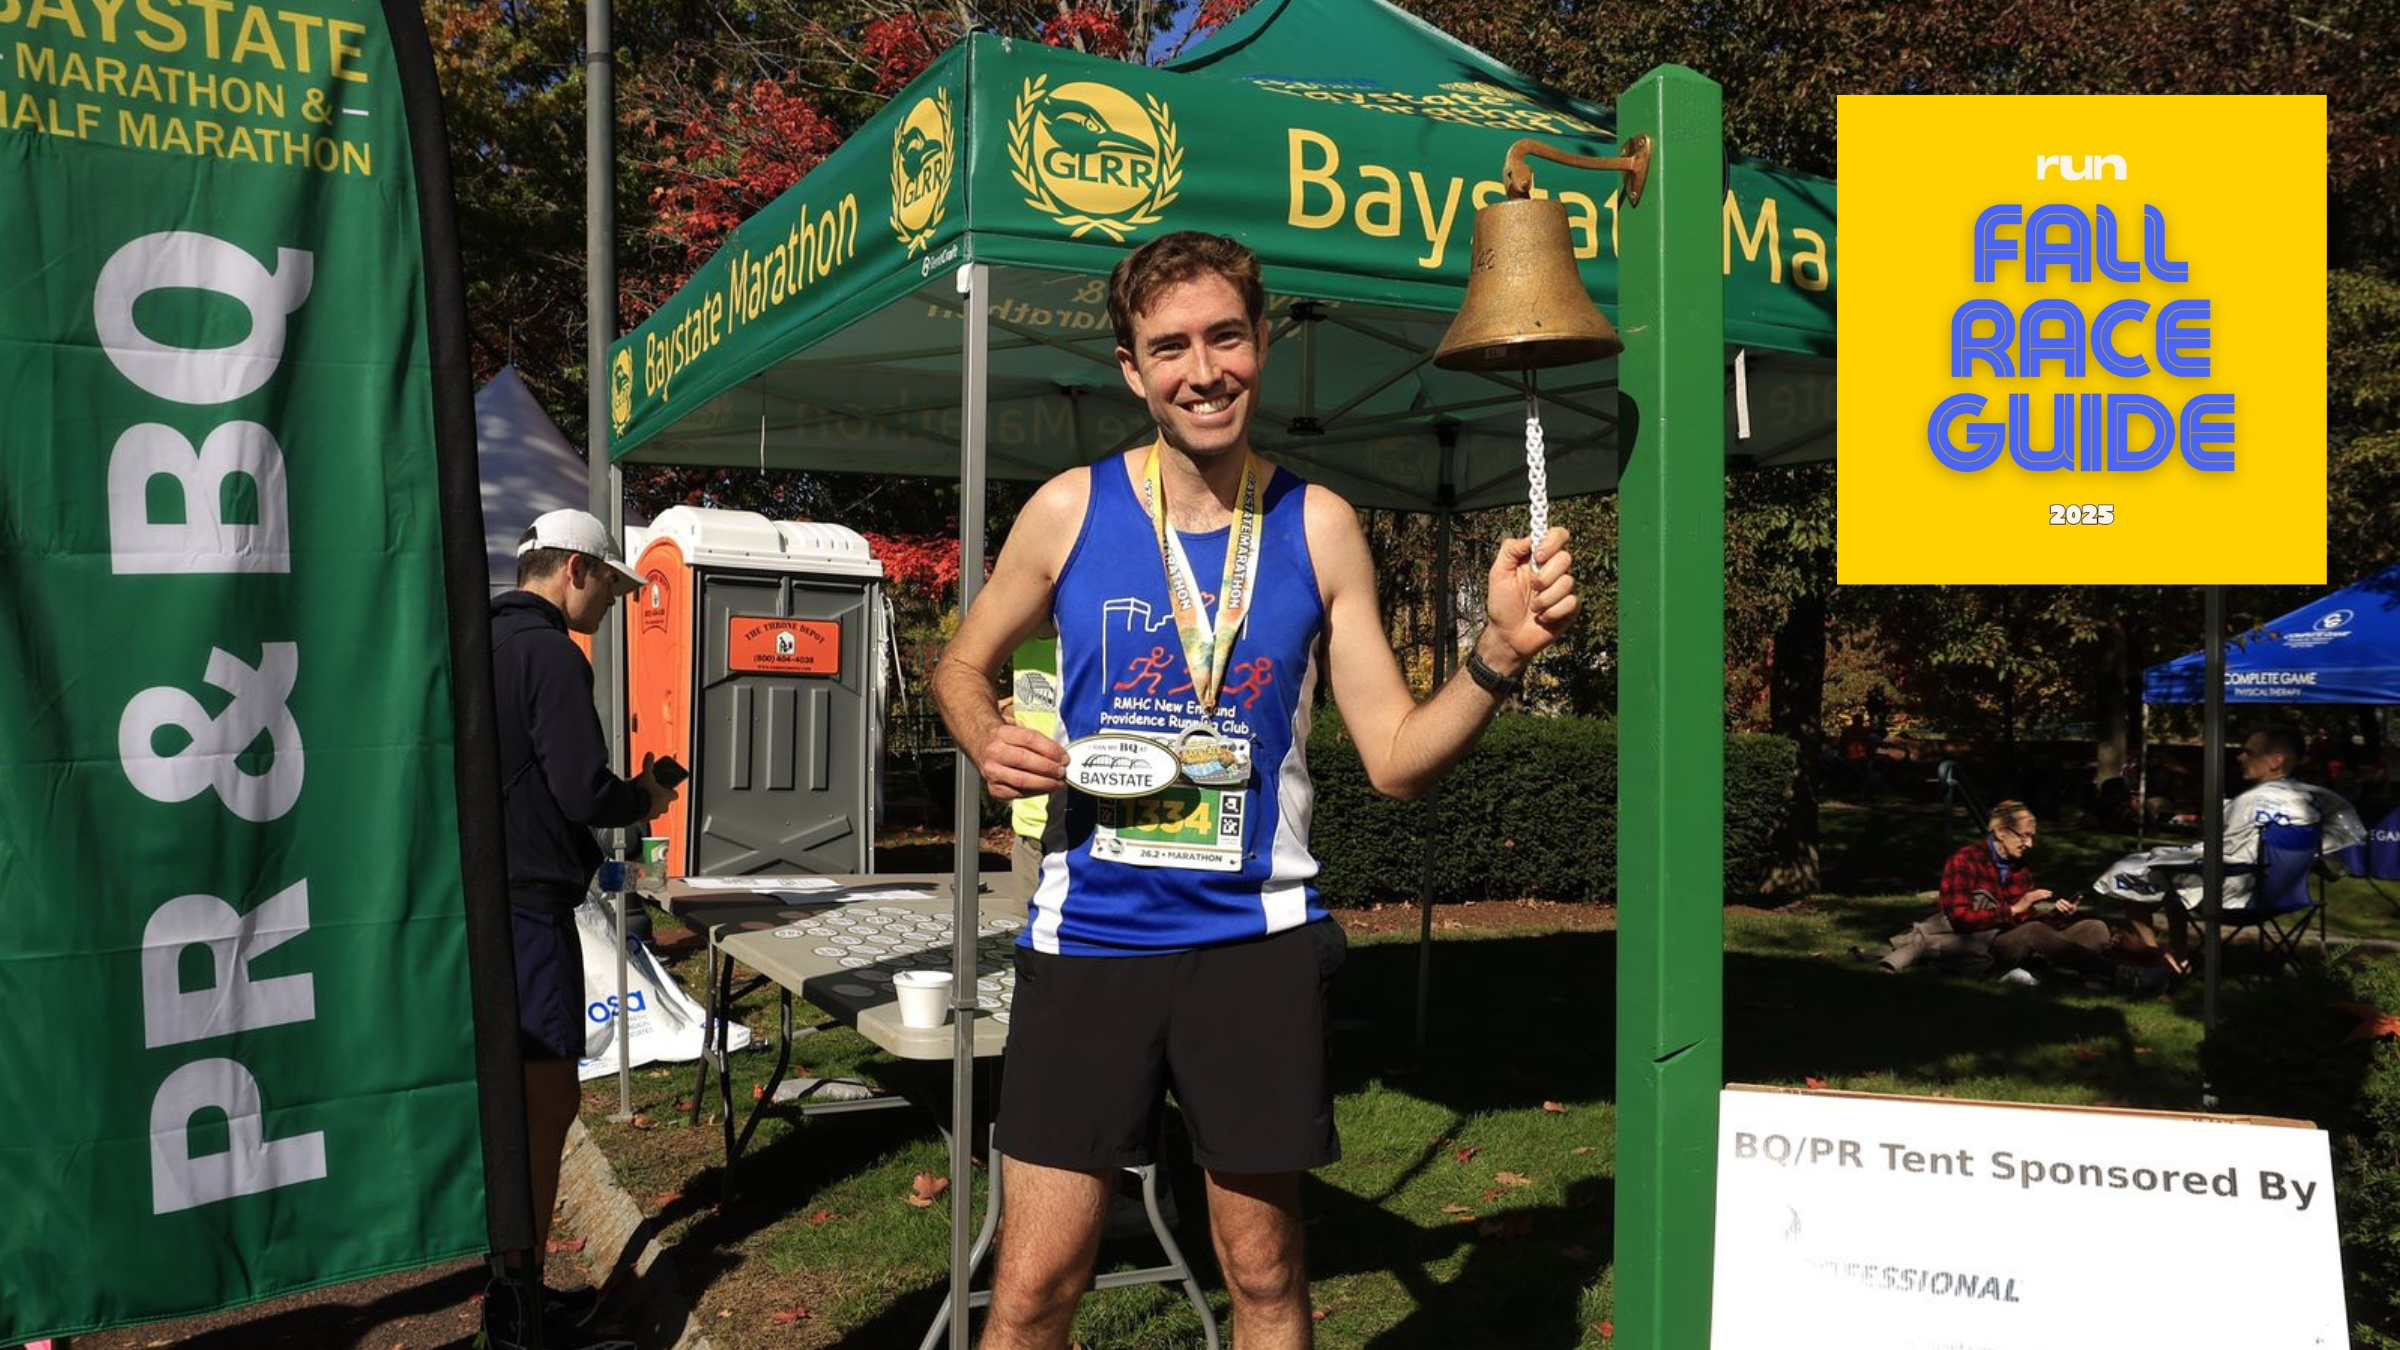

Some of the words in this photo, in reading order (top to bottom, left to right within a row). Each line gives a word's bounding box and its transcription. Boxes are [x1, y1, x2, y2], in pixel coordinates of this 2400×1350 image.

[0, 0, 369, 83] AYSTATE
[14, 42, 286, 118] MARATHON
[301, 87, 333, 126] &
[118, 109, 371, 176] MARATHON
[1042, 145, 1156, 190] GLRR
[902, 157, 944, 208] GLRR
[1287, 128, 1618, 269] Bayat
[1723, 191, 1838, 291] Ma
[644, 290, 723, 402] Baystate
[728, 192, 858, 335] Marathon
[93, 230, 314, 575] BQ
[1164, 543, 1192, 611] RATHON
[1228, 535, 1252, 609] MARATHON
[745, 626, 762, 641] THE
[763, 621, 799, 632] THRONE
[799, 624, 825, 644] DEPOT
[1113, 697, 1152, 711] RMHC
[1154, 701, 1184, 714] New
[1186, 701, 1237, 718] Enand
[2280, 672, 2318, 685] GAME
[117, 641, 305, 823] &
[1100, 712, 1166, 727] Providence
[1221, 720, 1250, 735] Club
[1119, 742, 1138, 754] BQ
[1080, 771, 1153, 788] BAYSTATE
[1122, 800, 1213, 836] 1334
[1140, 849, 1160, 859] 26.2
[1167, 851, 1223, 863] MARATHON
[141, 877, 328, 1216] PR
[1734, 1131, 1864, 1168] BQ/PR
[1879, 1143, 1974, 1178] Tent
[1991, 1151, 2240, 1198] Sponsored
[2260, 1171, 2317, 1212] By
